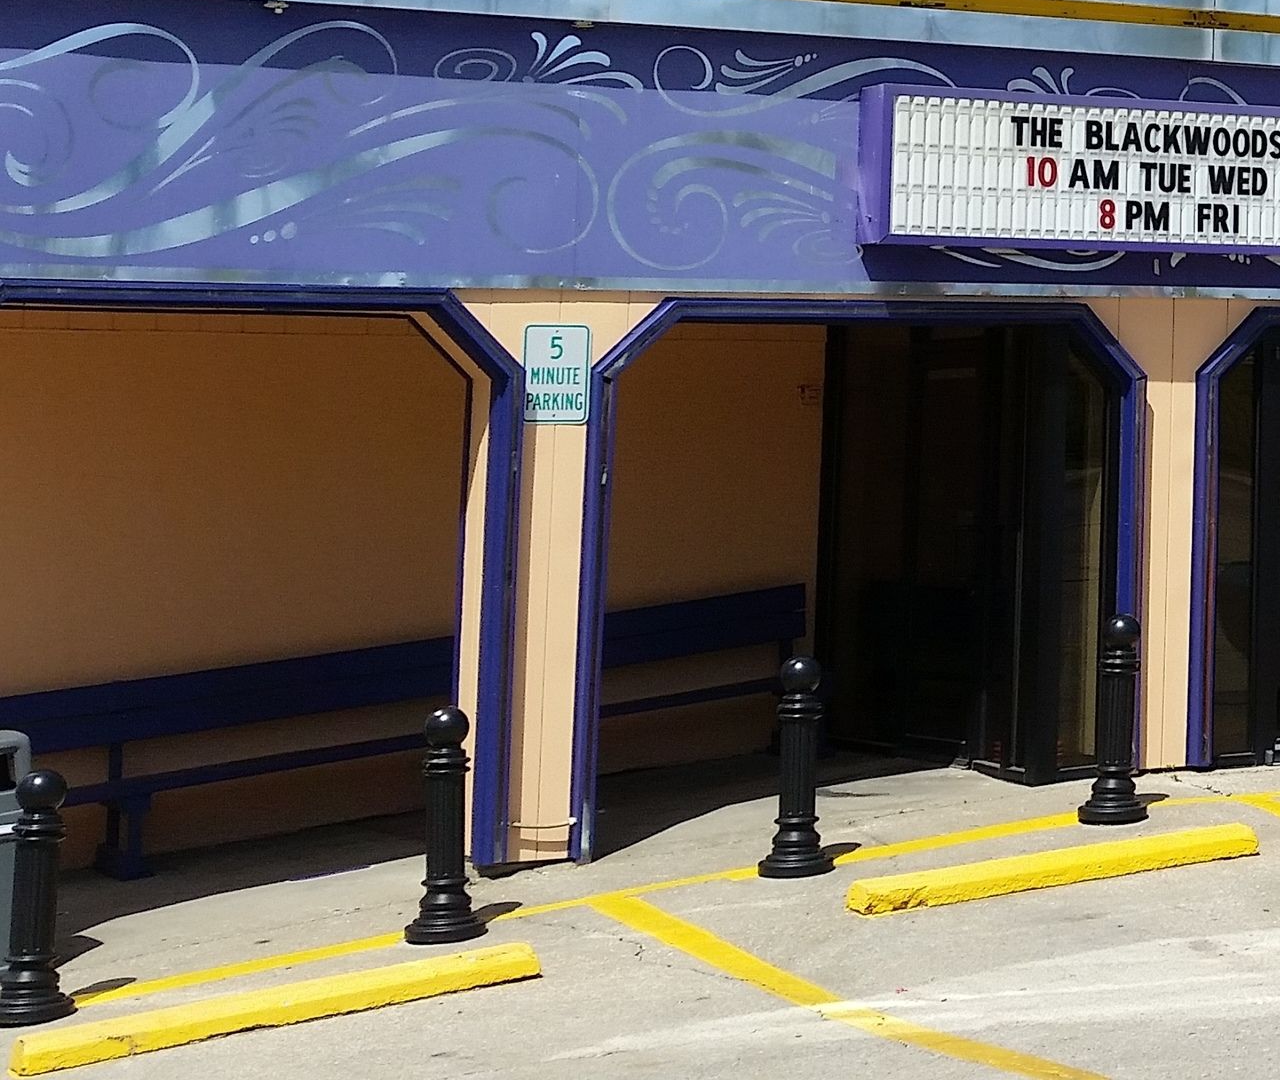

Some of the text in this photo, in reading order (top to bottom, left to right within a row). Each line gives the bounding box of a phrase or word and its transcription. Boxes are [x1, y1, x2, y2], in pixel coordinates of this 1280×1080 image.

[1011, 115, 1063, 148] THE
[1026, 156, 1057, 188] 10
[1068, 158, 1119, 191] AM
[1141, 161, 1191, 194] TUE
[1208, 163, 1268, 197] WED
[1099, 199, 1239, 234] 8 PM FRI
[550, 336, 563, 360] 5
[530, 367, 580, 385] MINUTE
[525, 392, 583, 411] PARKING
